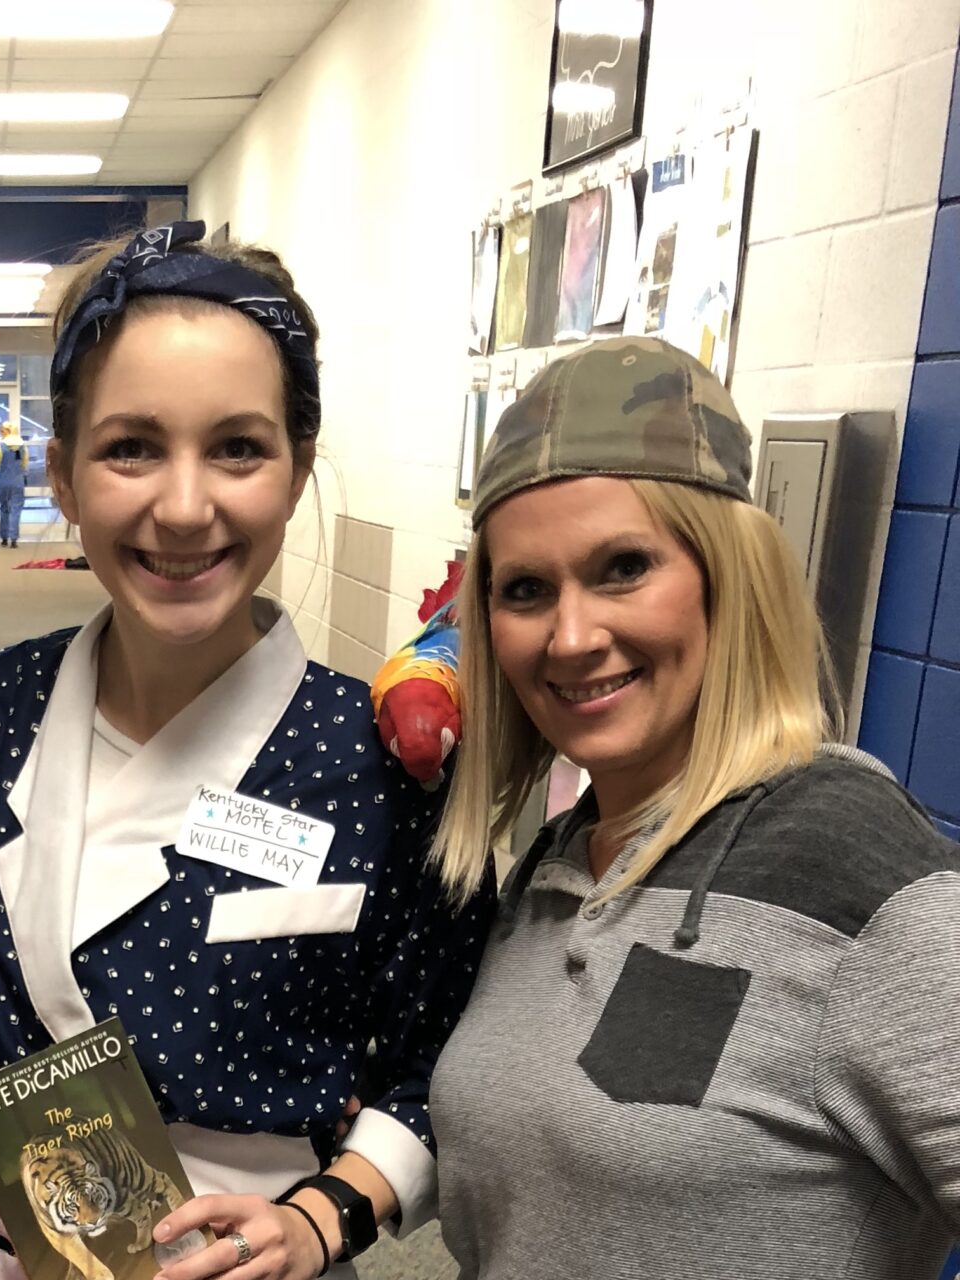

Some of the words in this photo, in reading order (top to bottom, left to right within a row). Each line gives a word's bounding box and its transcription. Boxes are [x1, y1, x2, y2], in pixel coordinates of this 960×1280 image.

[198, 787, 270, 822] Kentucky
[281, 814, 318, 833] Star
[224, 811, 289, 841] MOTEL
[189, 829, 249, 858] WILLIE
[261, 848, 304, 880] MAY
[11, 1067, 32, 1079] TIMES
[33, 1044, 79, 1070] BEST-SELLING
[80, 1031, 108, 1047] AUTHOR
[22, 1135, 62, 1159] Tiger
[65, 1112, 113, 1142] Rising
[44, 1106, 73, 1126] The
